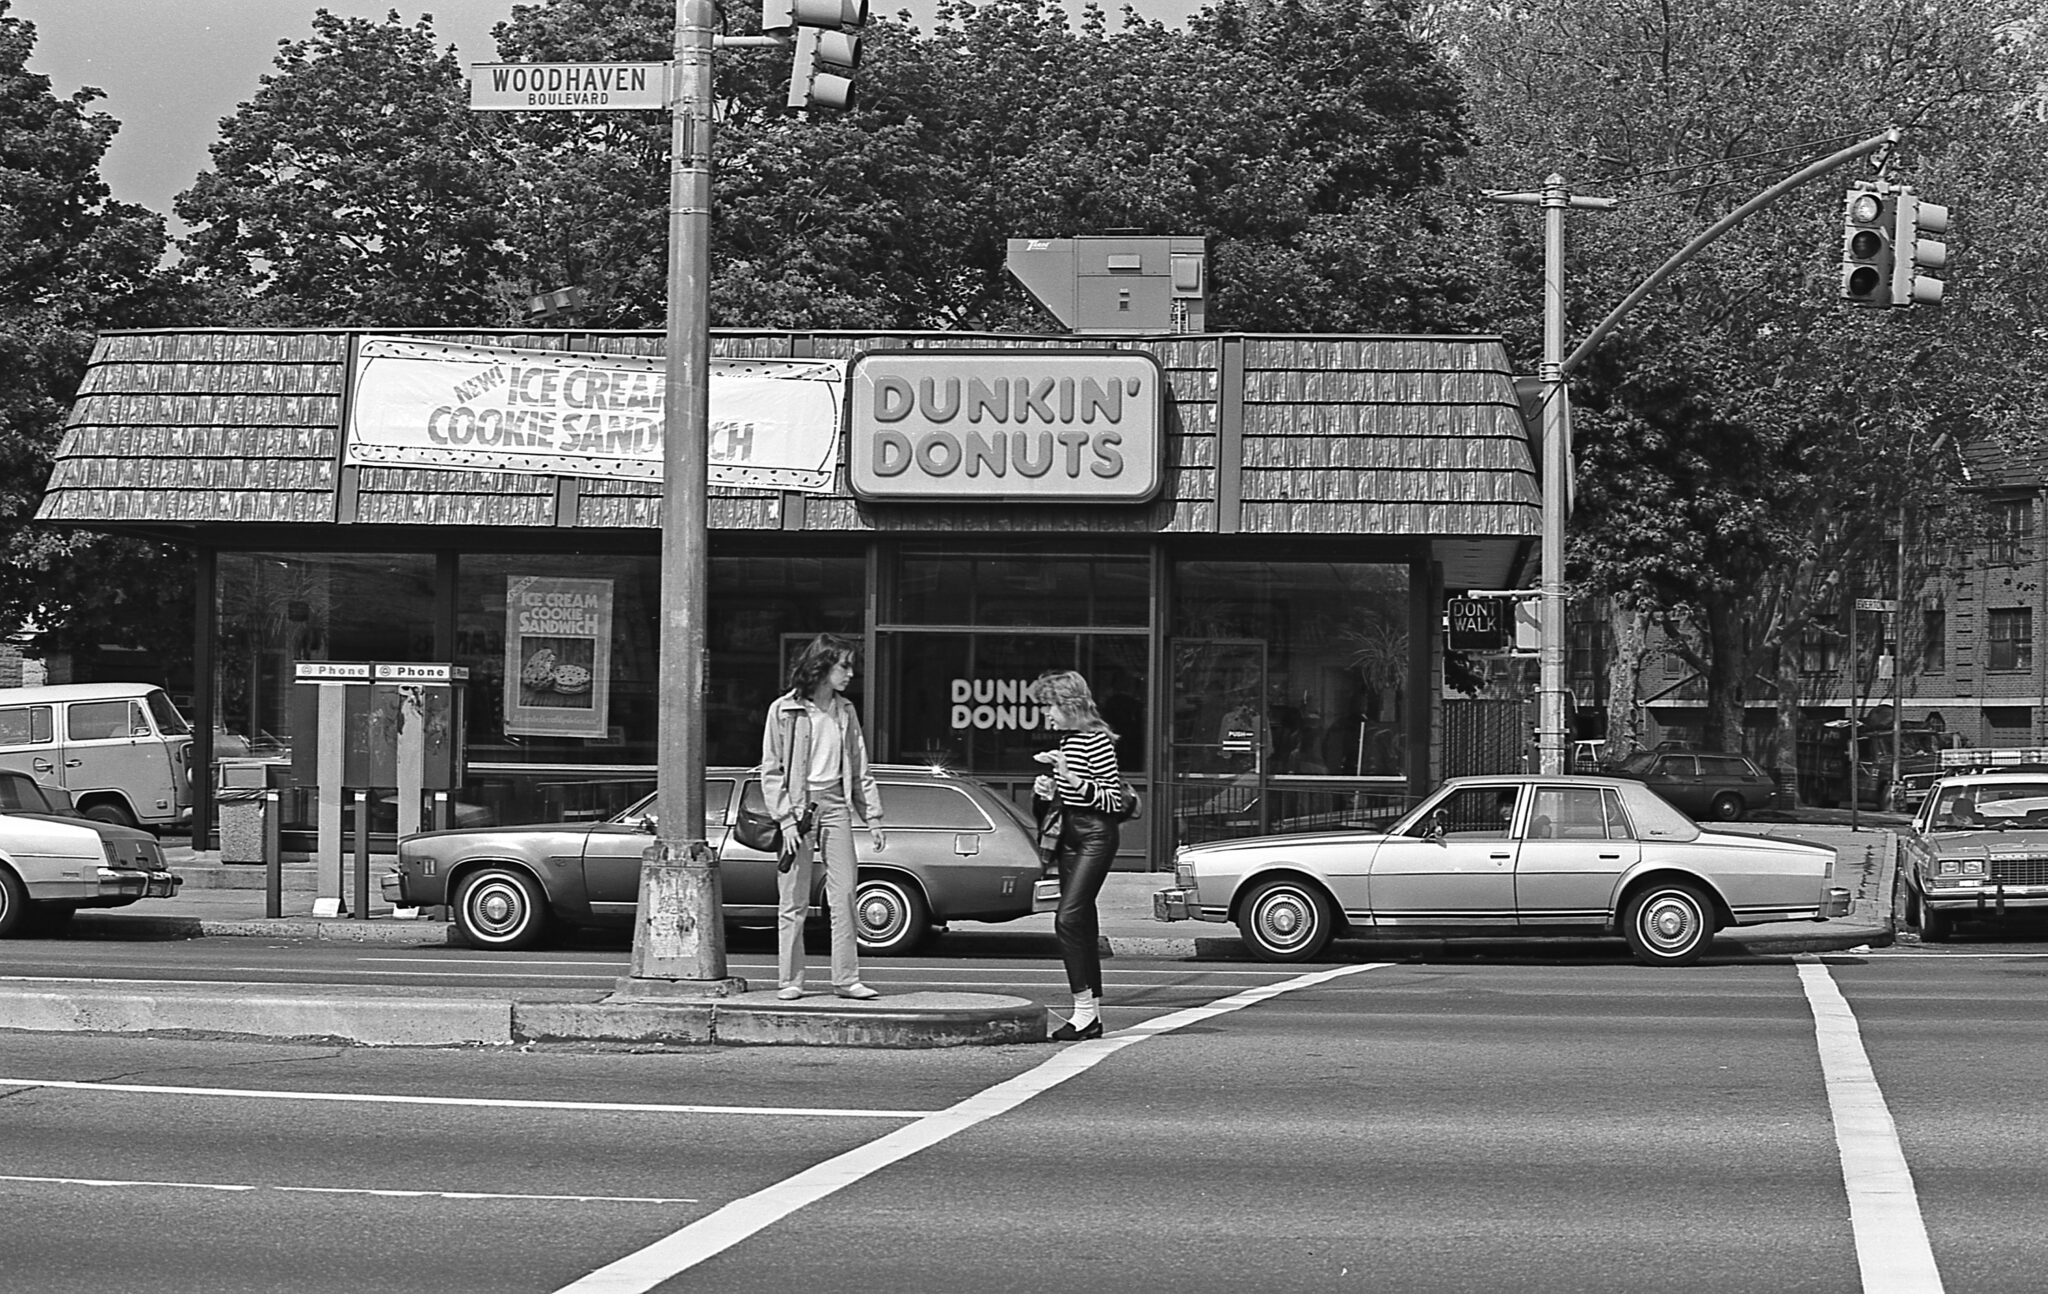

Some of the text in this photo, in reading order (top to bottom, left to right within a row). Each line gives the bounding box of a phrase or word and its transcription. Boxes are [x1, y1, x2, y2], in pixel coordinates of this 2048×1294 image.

[493, 68, 645, 91] WOODHAVEN
[528, 93, 609, 105] BOULEVARD
[453, 365, 506, 404] NEW!
[507, 366, 560, 406] ICE
[873, 375, 1141, 424] DUNKIN'
[427, 405, 755, 461] COOKIE SANDCH
[872, 430, 1124, 478] DONUTS
[520, 592, 598, 609] ICE CREAM
[1454, 602, 1496, 616] DONT
[519, 612, 598, 634] SANDWICH
[531, 607, 583, 620] COOKIE
[1454, 617, 1497, 632] WALK
[318, 667, 365, 676] Phone
[397, 667, 444, 677] Phone
[951, 679, 1041, 704] DUNK
[951, 705, 1052, 730] DONUT
